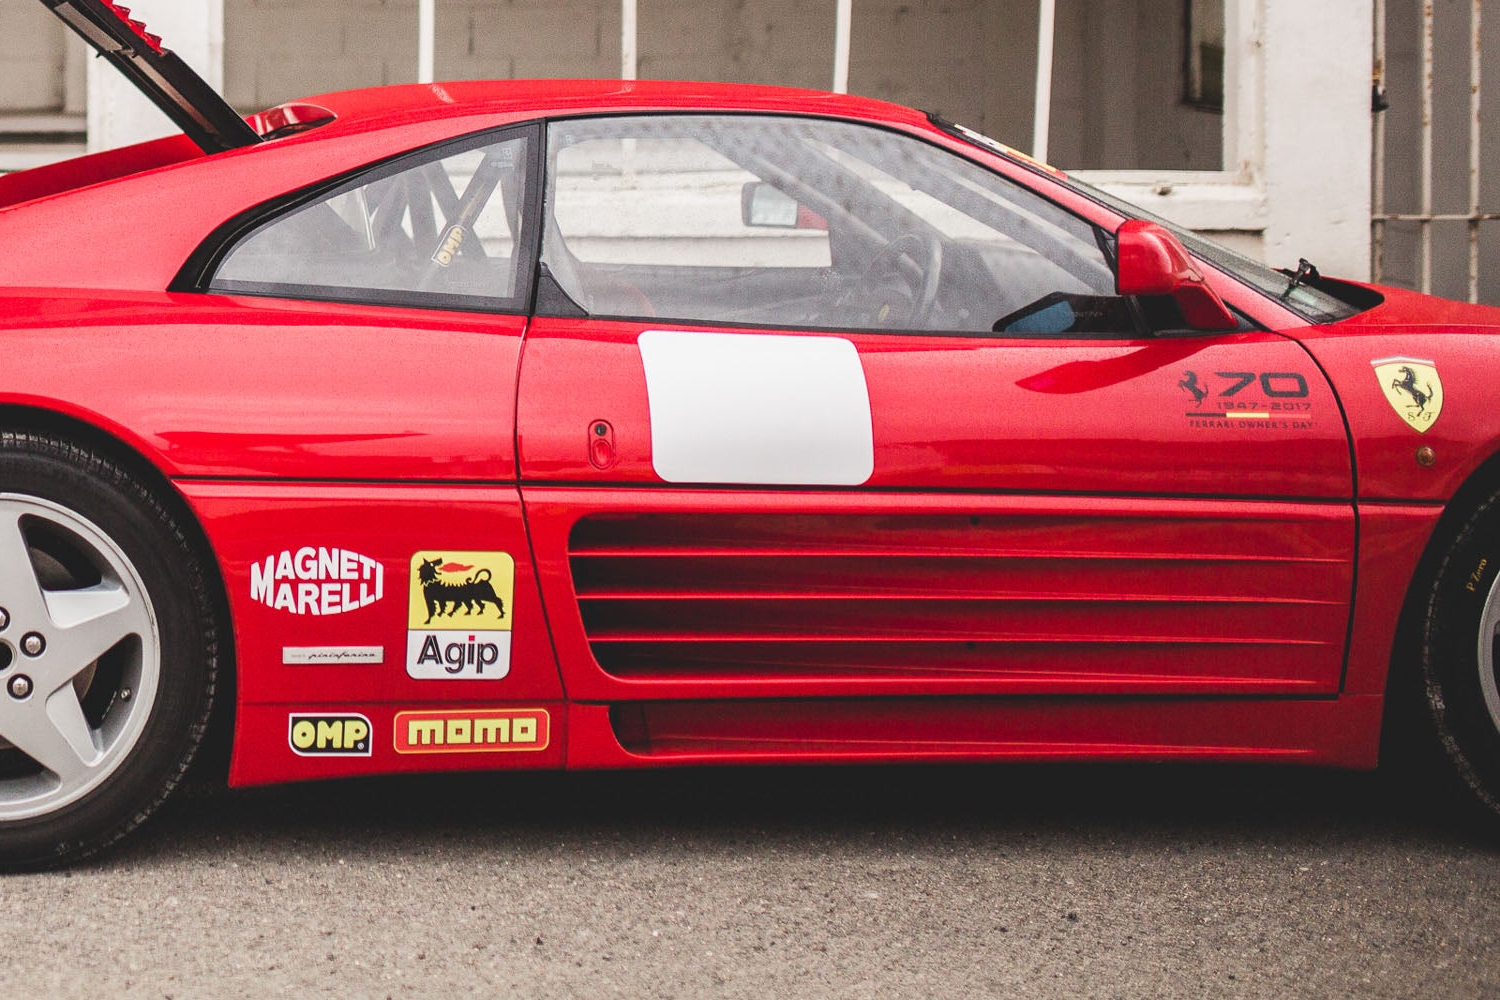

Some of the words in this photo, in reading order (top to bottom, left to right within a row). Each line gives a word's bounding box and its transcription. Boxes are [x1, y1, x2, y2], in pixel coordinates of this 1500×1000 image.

[1214, 372, 1309, 398] 70
[1218, 402, 1311, 410] 1947-2017
[1239, 421, 1288, 429] OWNER'S
[251, 547, 384, 590] MAGNETI
[417, 635, 499, 674] Agip
